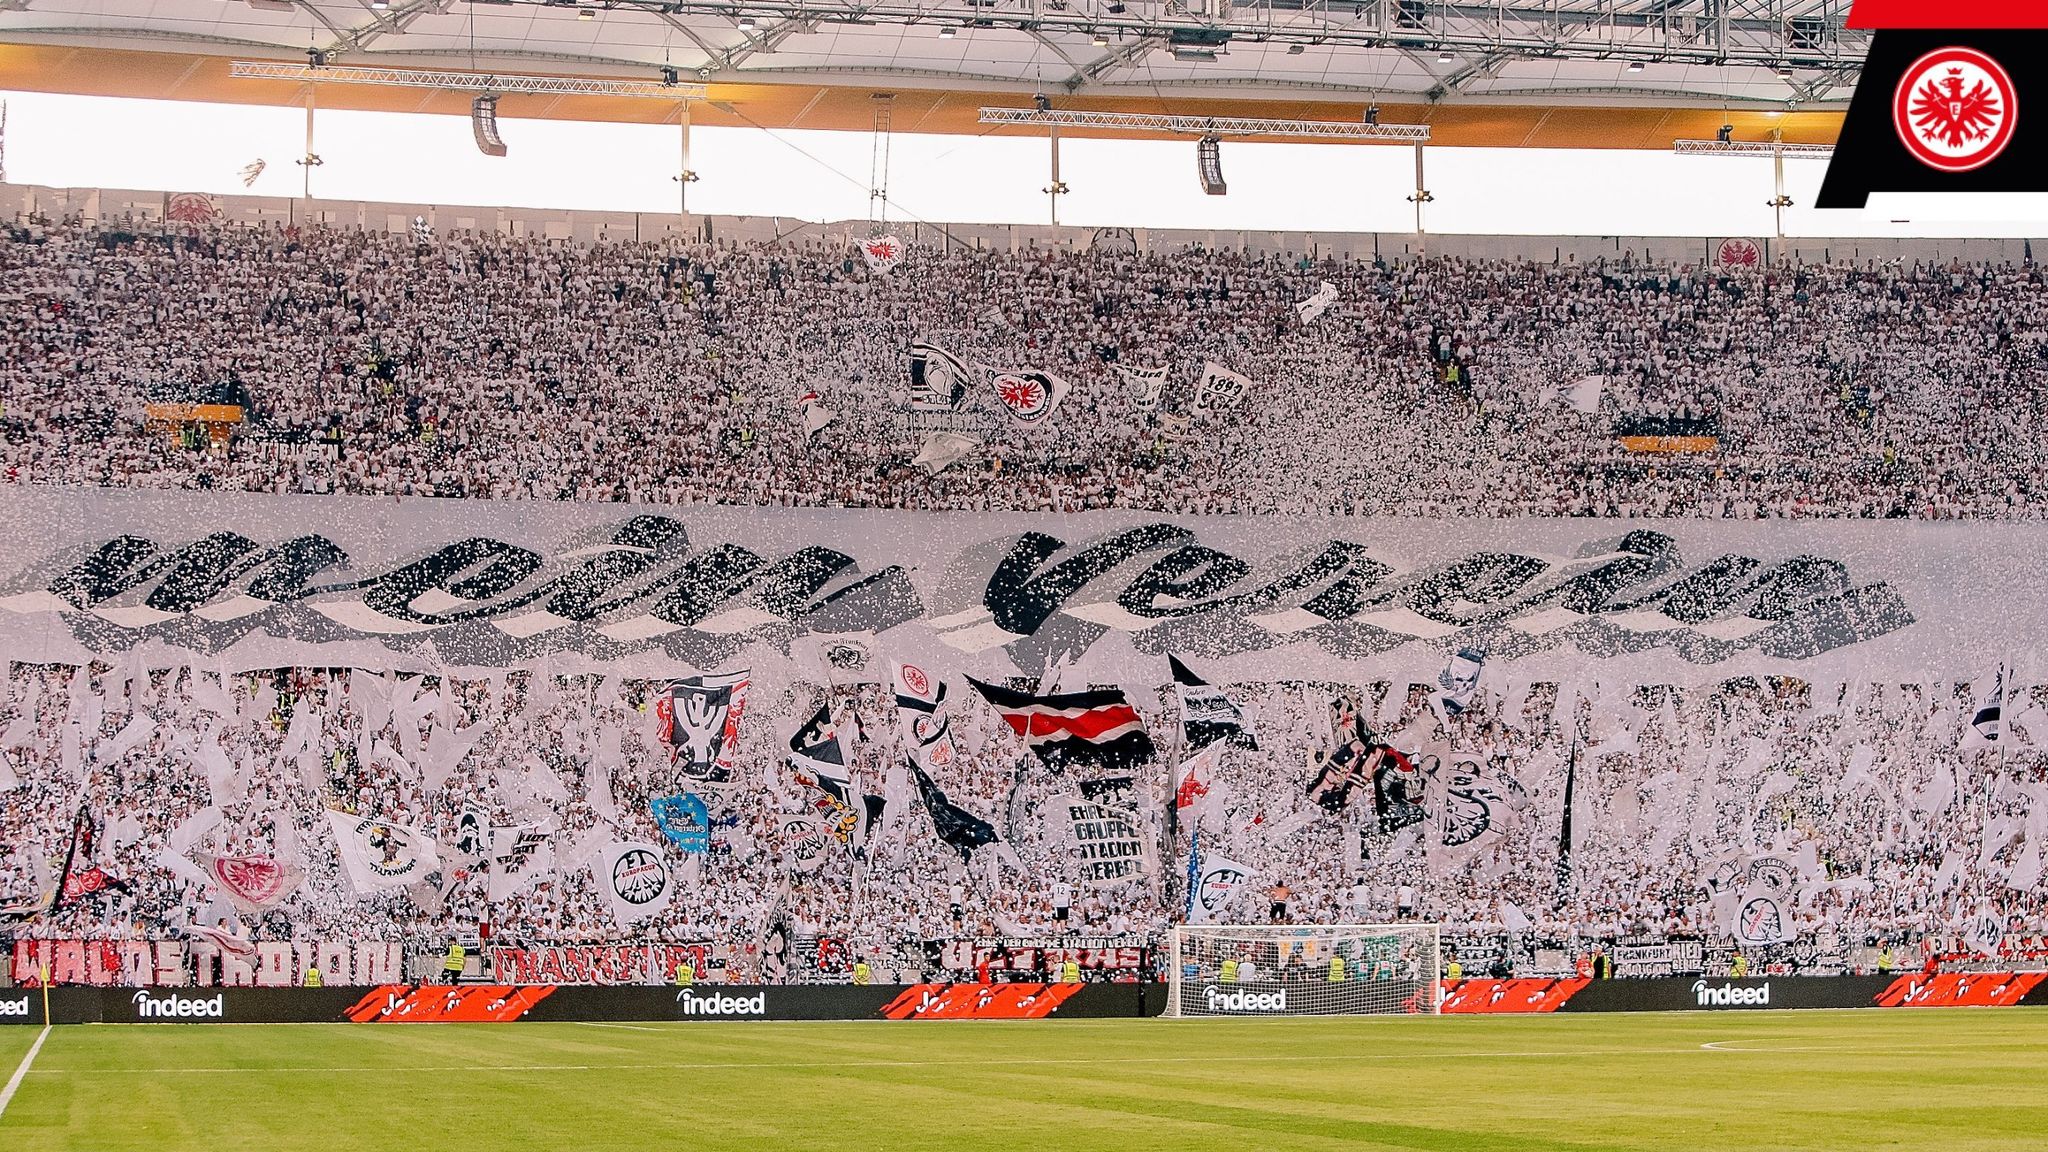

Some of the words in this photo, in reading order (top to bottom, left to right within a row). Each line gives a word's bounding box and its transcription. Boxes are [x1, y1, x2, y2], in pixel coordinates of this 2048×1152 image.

[48, 514, 918, 628] mein
[984, 522, 1897, 635] Verein
[1069, 805, 1104, 820] EHRE
[621, 864, 656, 878] EUROPACUP
[132, 990, 223, 1017] indeed
[676, 988, 765, 1015] indeed
[1202, 985, 1286, 1010] indeed
[1691, 980, 1769, 1005] indeed
